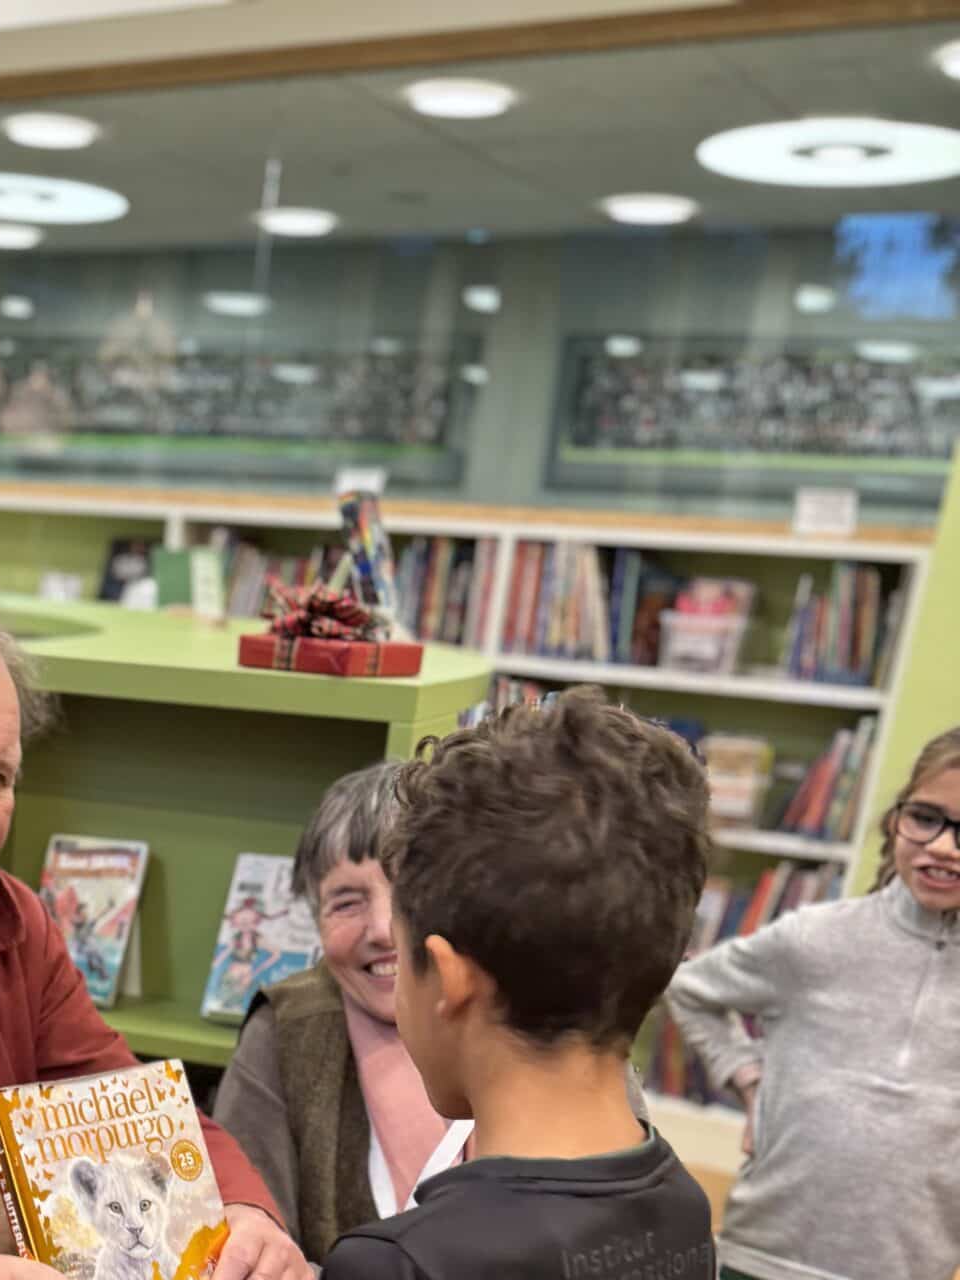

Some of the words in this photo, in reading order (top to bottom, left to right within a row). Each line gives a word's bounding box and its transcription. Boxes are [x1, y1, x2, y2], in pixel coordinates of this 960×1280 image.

[40, 1079, 158, 1131] michael
[36, 1113, 175, 1164] morpurgo
[178, 1151, 195, 1168] 25
